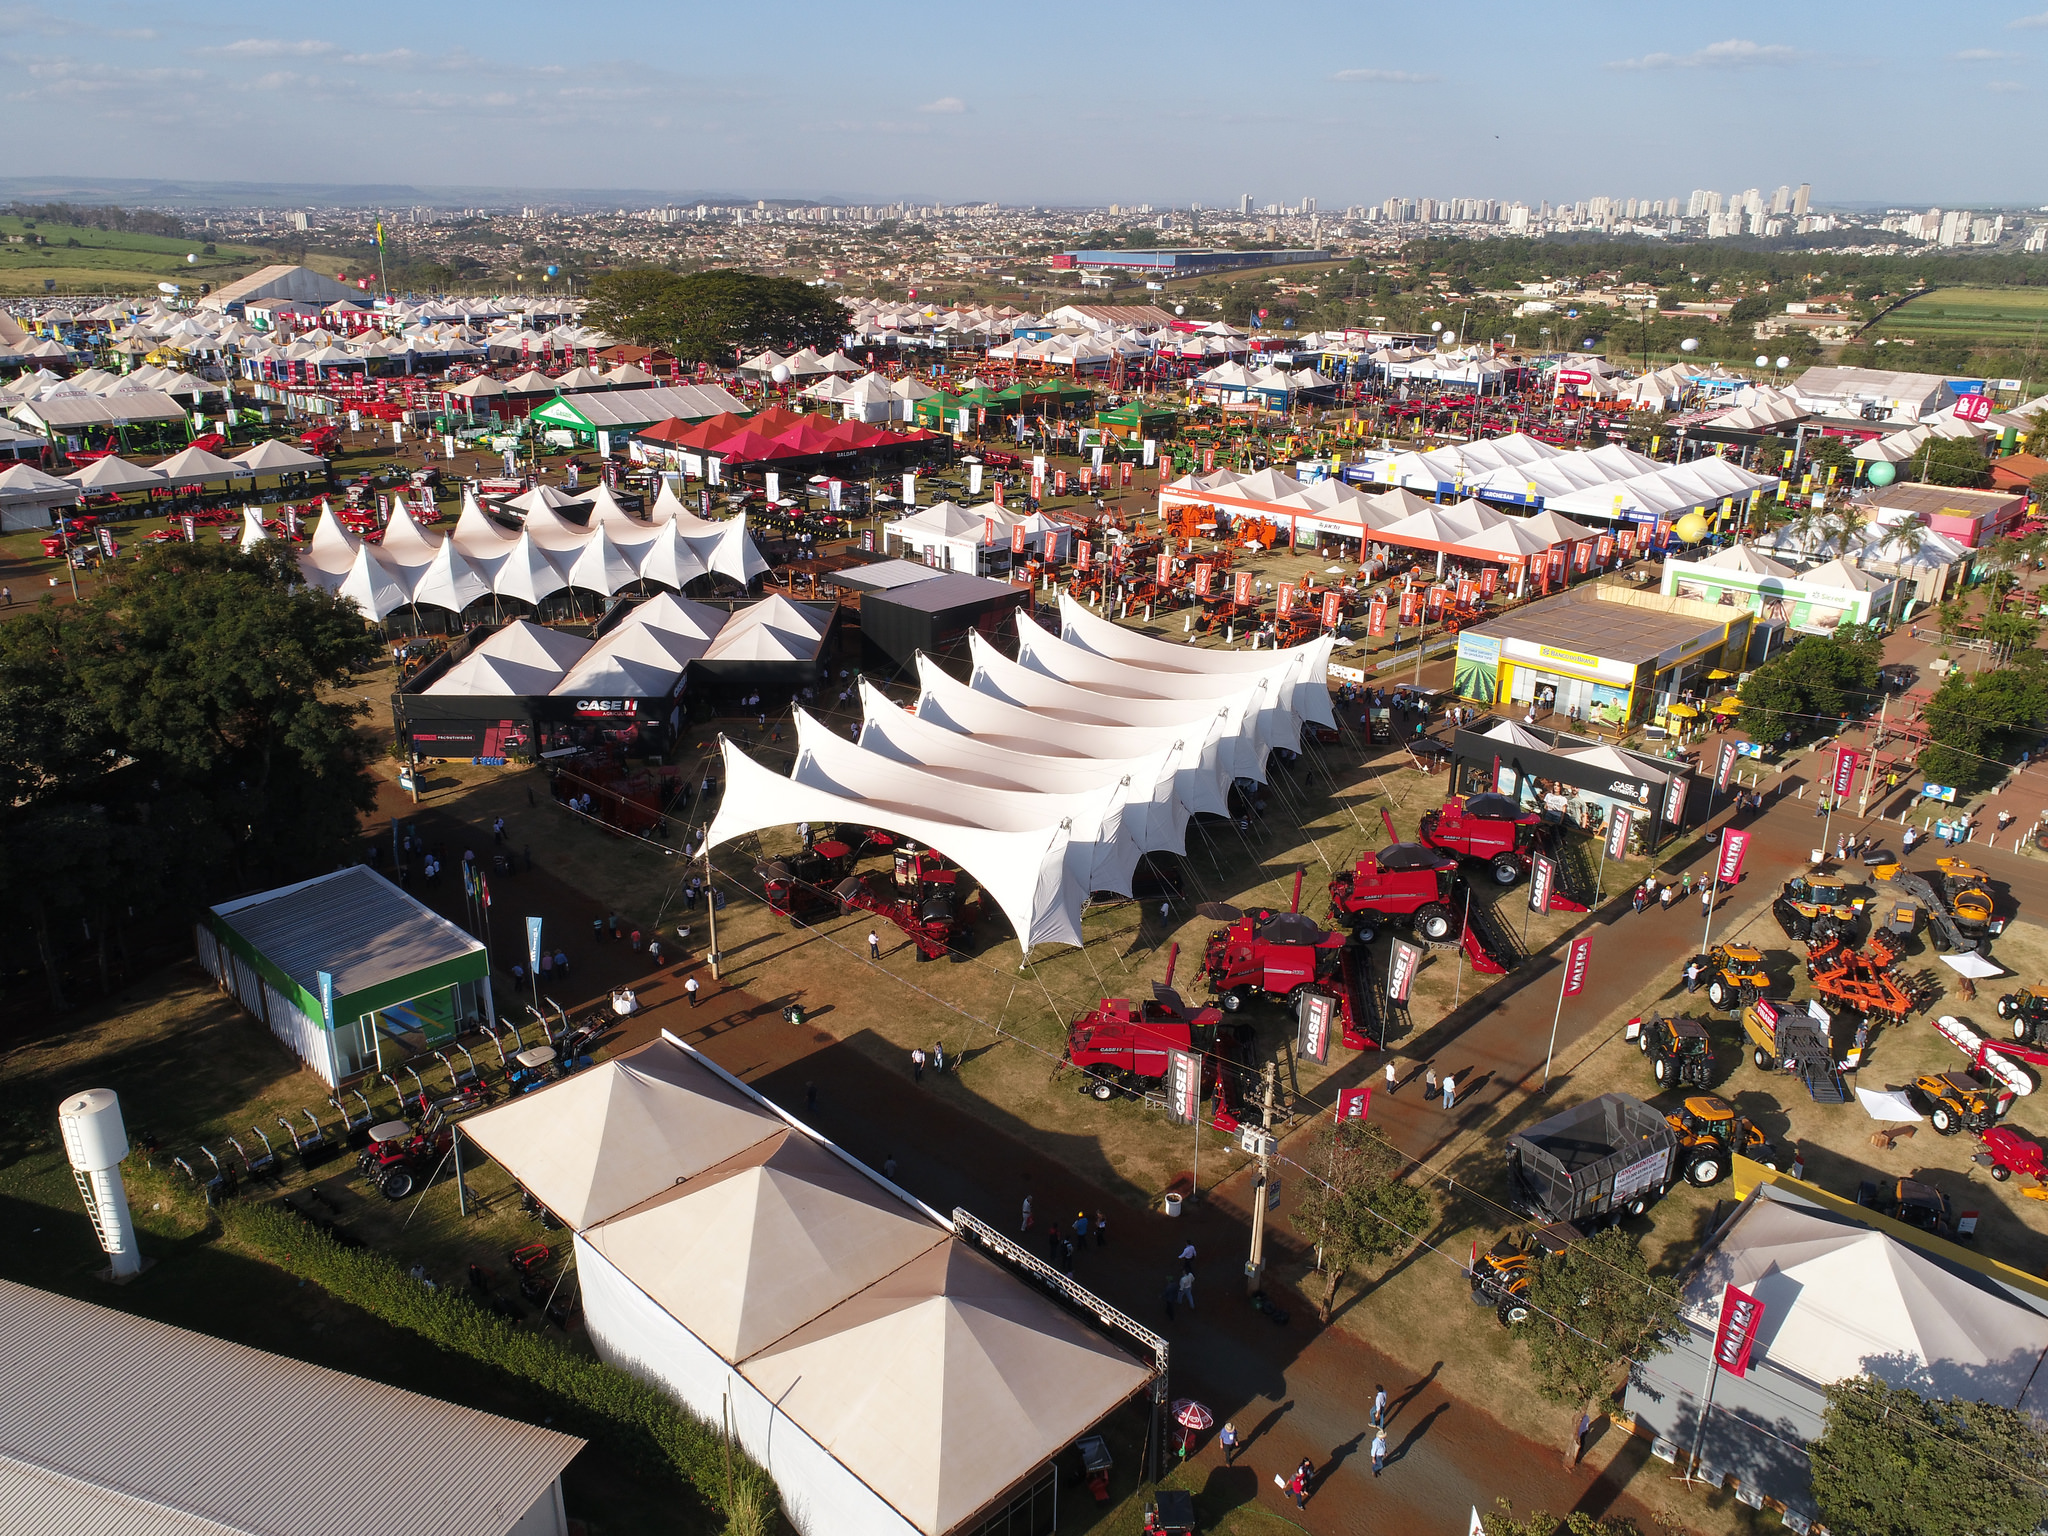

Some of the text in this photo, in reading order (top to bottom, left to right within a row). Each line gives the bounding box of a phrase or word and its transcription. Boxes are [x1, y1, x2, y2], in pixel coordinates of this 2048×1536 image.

[836, 450, 857, 458] BALDAN
[1822, 592, 1846, 602] Sicredi
[1550, 650, 1569, 660] BANCO
[1577, 656, 1595, 665] BRASIL
[576, 700, 622, 711] CASE
[1613, 780, 1635, 791] CASE
[1719, 756, 1730, 785] CASE
[1836, 755, 1853, 791] VALTRA
[1608, 784, 1639, 798] AUTHENTIC
[1666, 788, 1679, 820] CASE
[1609, 821, 1623, 854] CASE
[1721, 836, 1744, 878] VALTRA
[1533, 873, 1546, 908] CASE
[1390, 959, 1406, 999] CASE
[1568, 942, 1588, 992] VALTRA
[1306, 1011, 1321, 1055] CASE
[1757, 1005, 1775, 1030] FINAME
[1175, 1068, 1188, 1116] CASE
[1718, 1299, 1755, 1366] VALTRA
